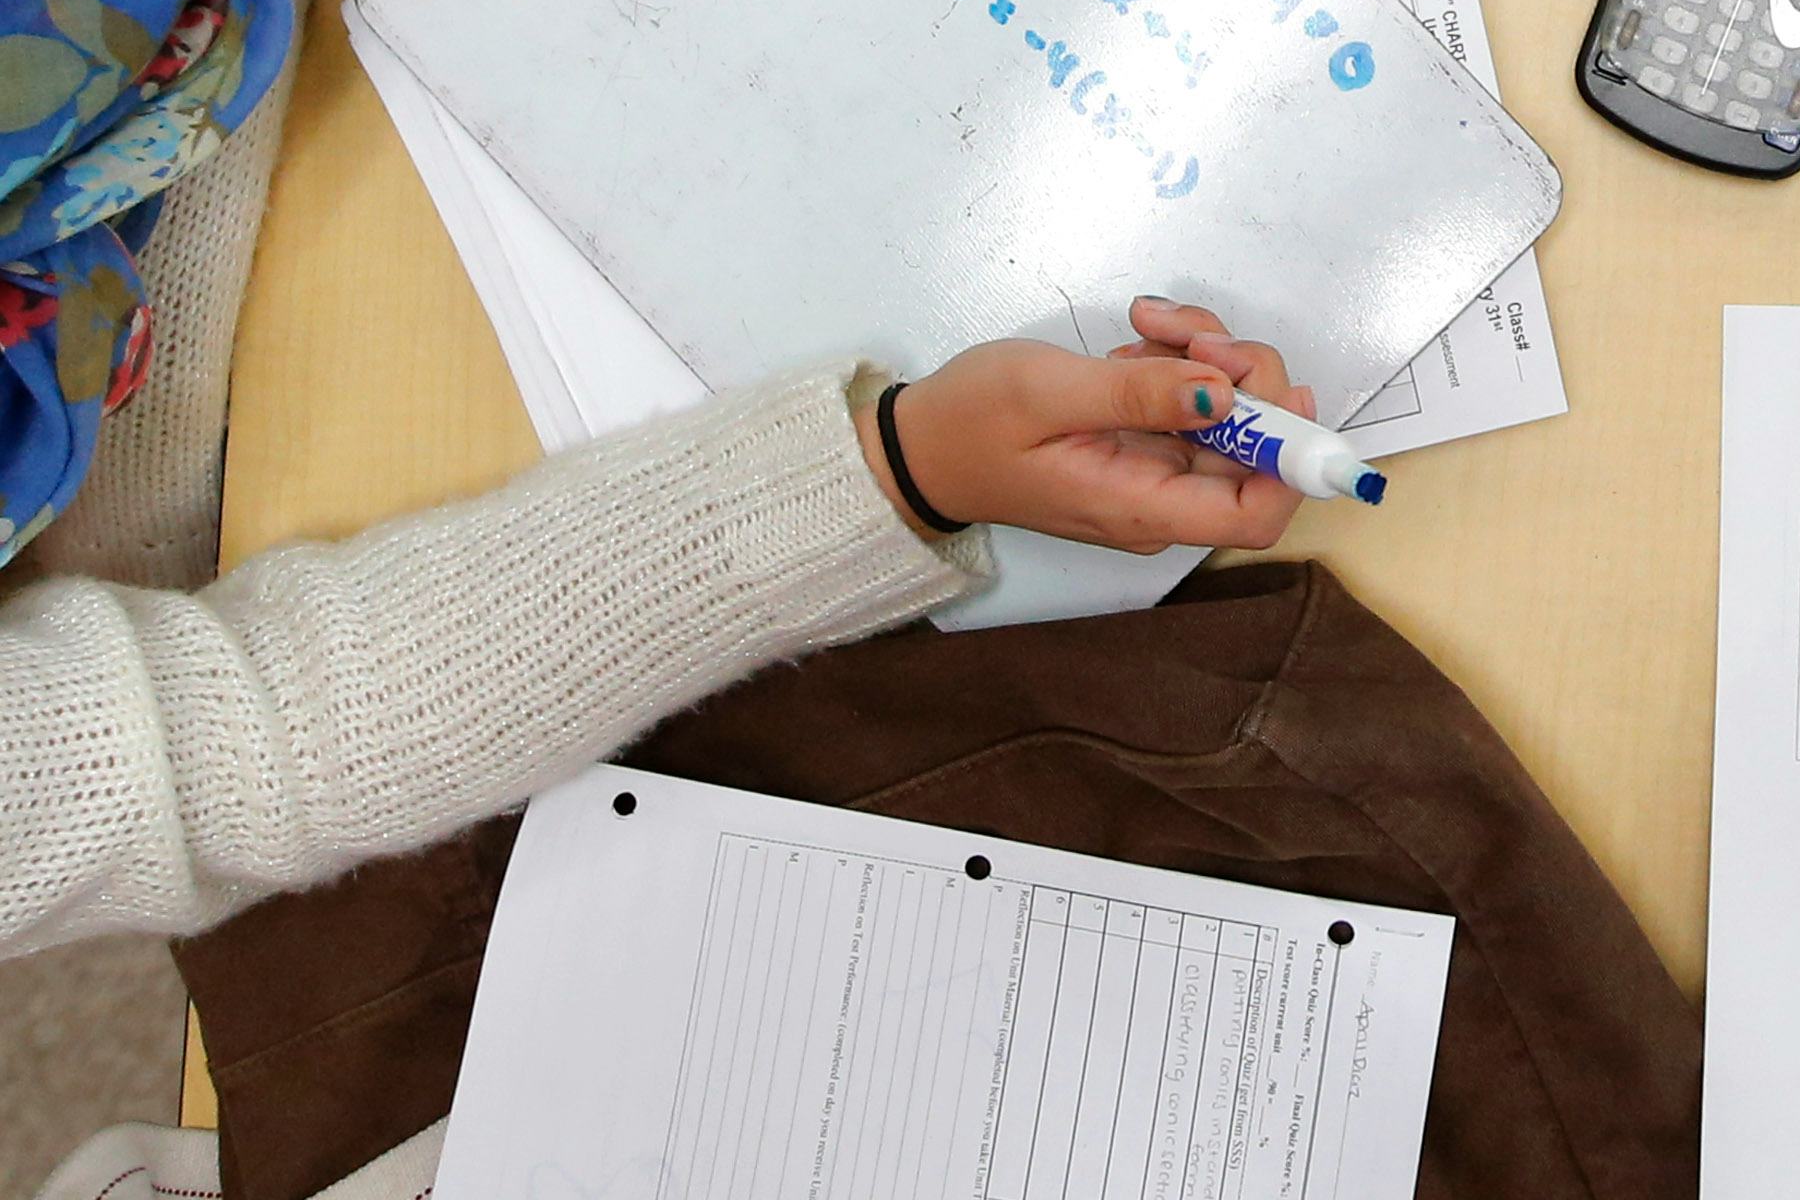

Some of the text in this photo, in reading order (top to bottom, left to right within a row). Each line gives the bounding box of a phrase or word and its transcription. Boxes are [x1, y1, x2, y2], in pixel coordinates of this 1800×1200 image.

[1506, 301, 1531, 351] Class#
[1306, 987, 1319, 1013] Quiz
[1302, 1015, 1315, 1044] Score
[1223, 967, 1268, 1170] Description of Quiz (get from SSS)
